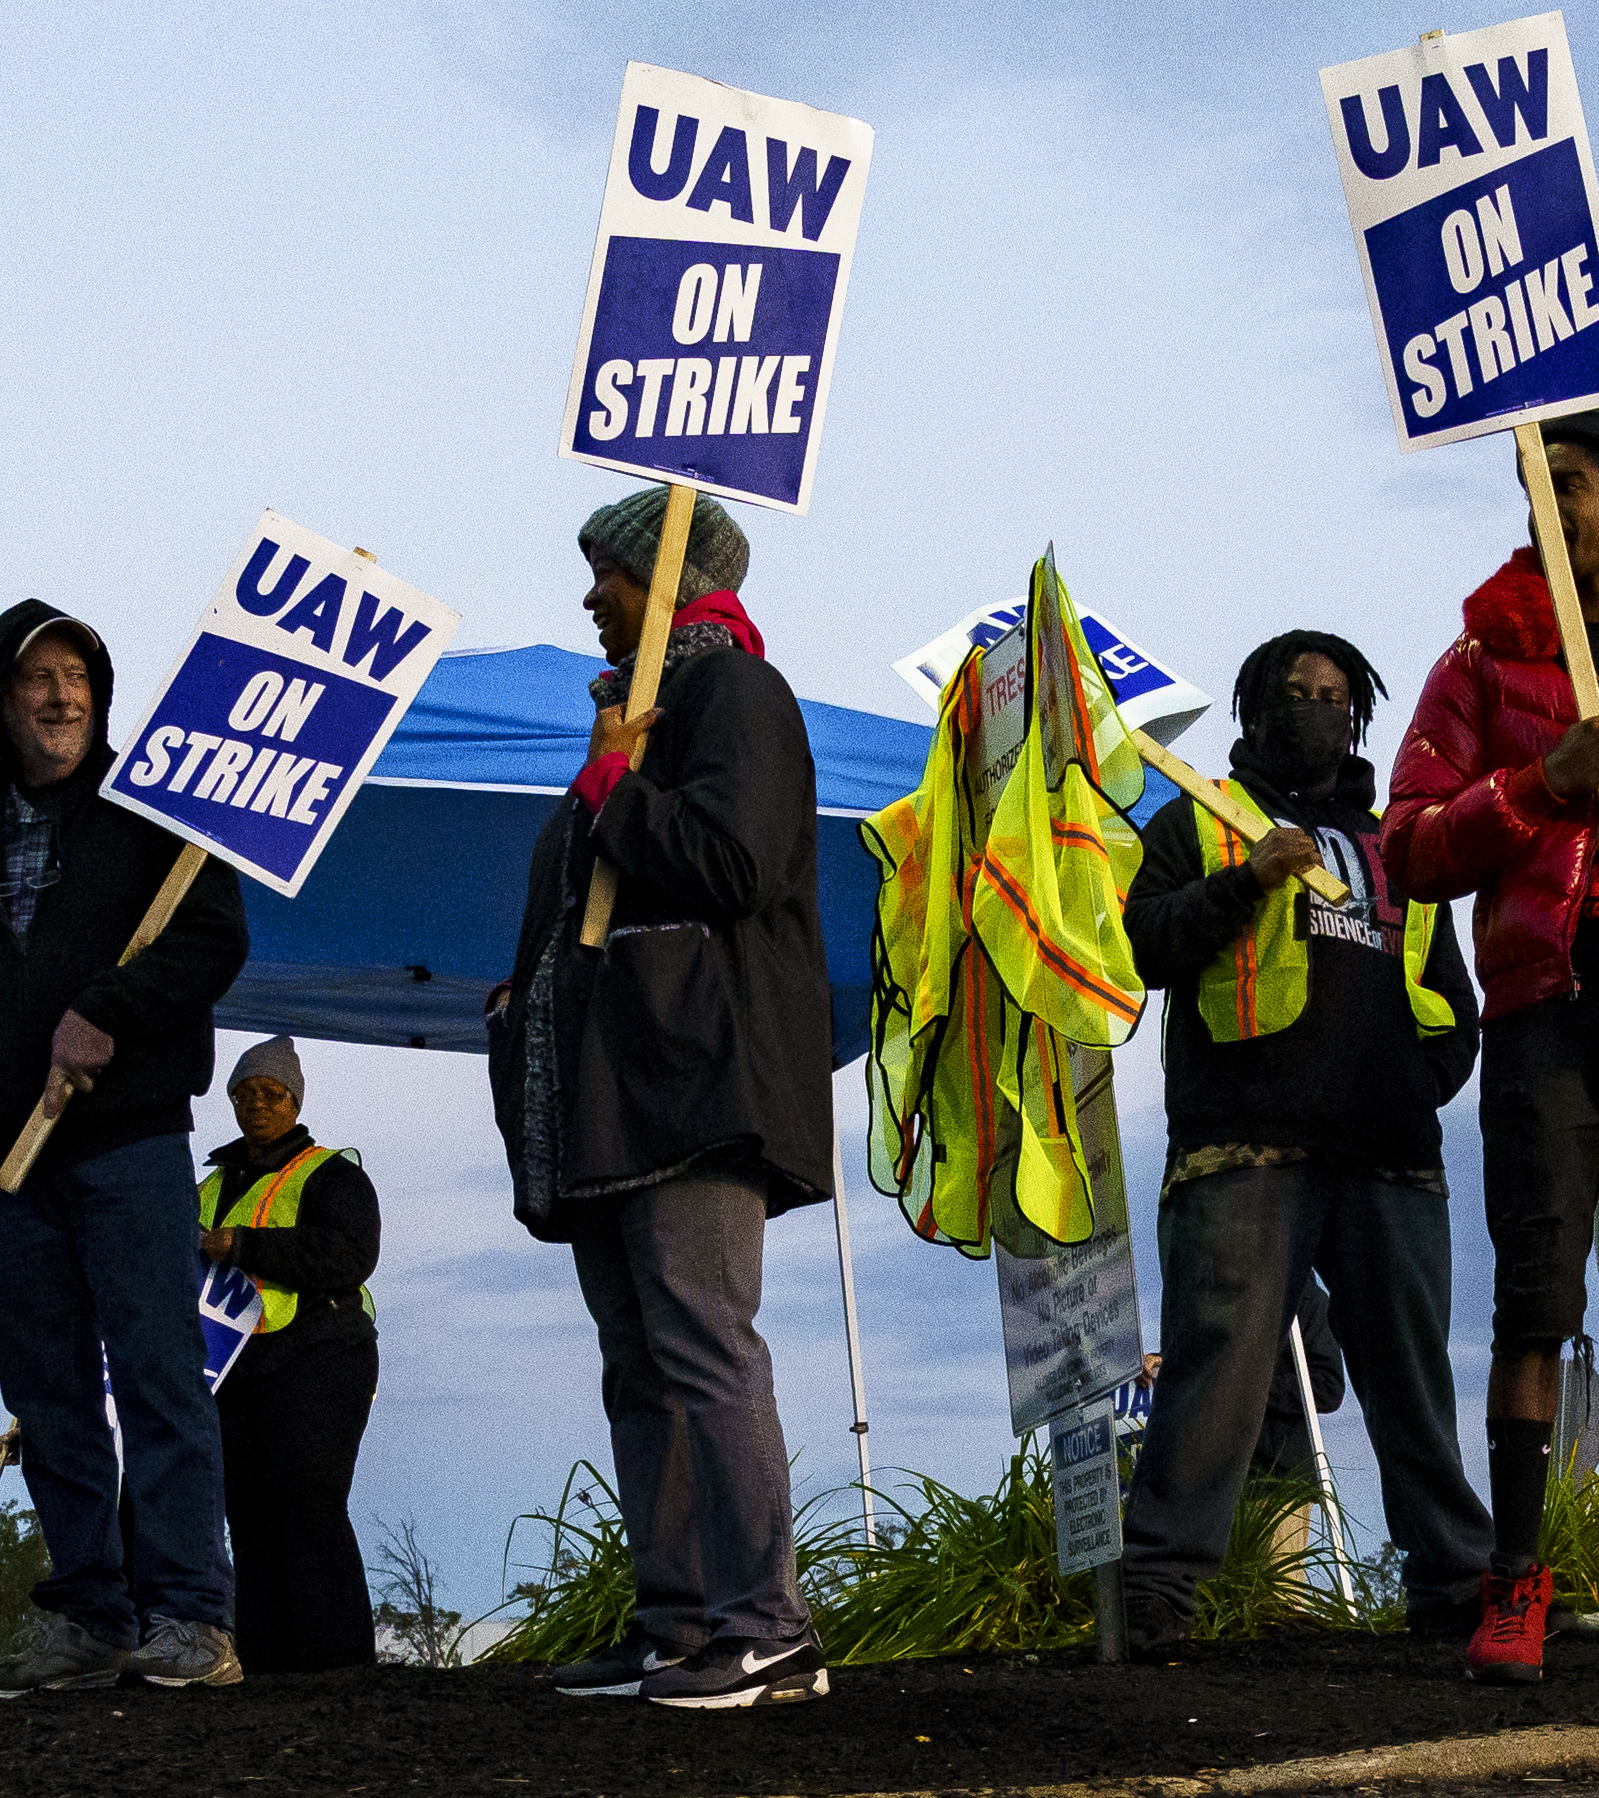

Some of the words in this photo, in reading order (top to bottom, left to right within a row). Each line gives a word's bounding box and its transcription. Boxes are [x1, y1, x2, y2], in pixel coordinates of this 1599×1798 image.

[1339, 48, 1549, 181] UAW
[628, 104, 852, 242] UAW
[1441, 184, 1524, 294] ON
[672, 263, 763, 345] ON
[589, 355, 811, 440] STRIKE
[235, 537, 432, 682] UAW
[228, 671, 326, 742] ON
[129, 726, 344, 825] STRIKE
[1063, 1424, 1102, 1464] NOTICE
